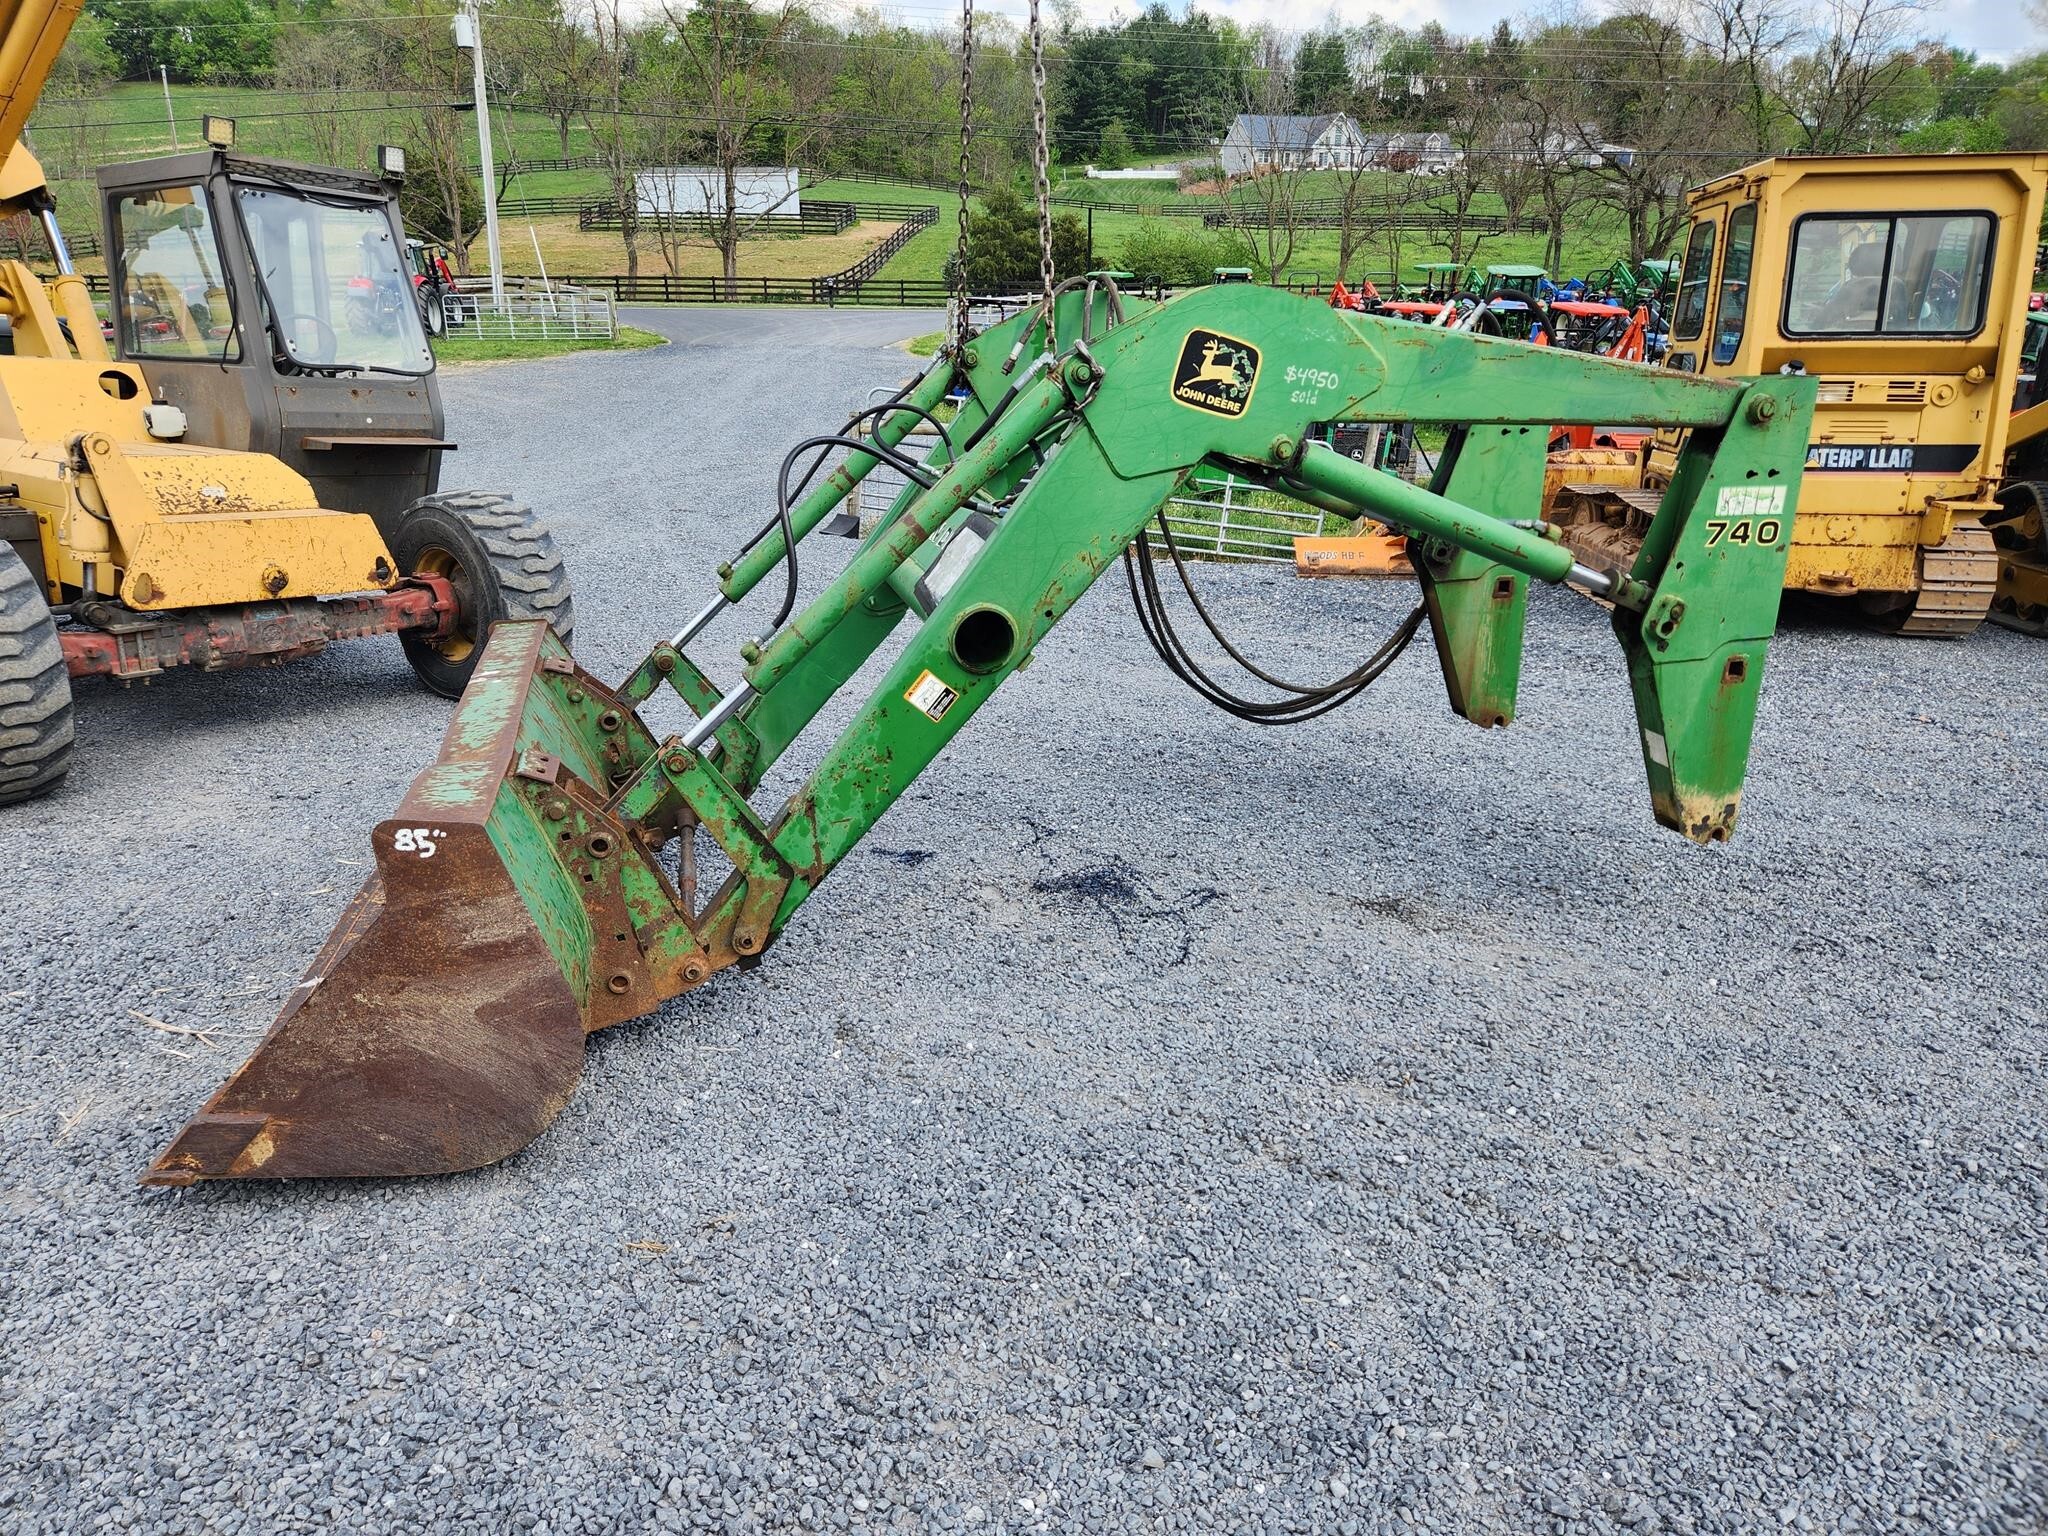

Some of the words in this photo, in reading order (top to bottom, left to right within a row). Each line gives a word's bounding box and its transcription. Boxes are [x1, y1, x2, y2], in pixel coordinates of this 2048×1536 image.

[1284, 365, 1339, 390] $4950
[1176, 386, 1206, 403] JOHN
[1206, 395, 1242, 413] DEERE
[1808, 448, 1914, 468] ATERPLLAR
[1704, 519, 1781, 548] 740
